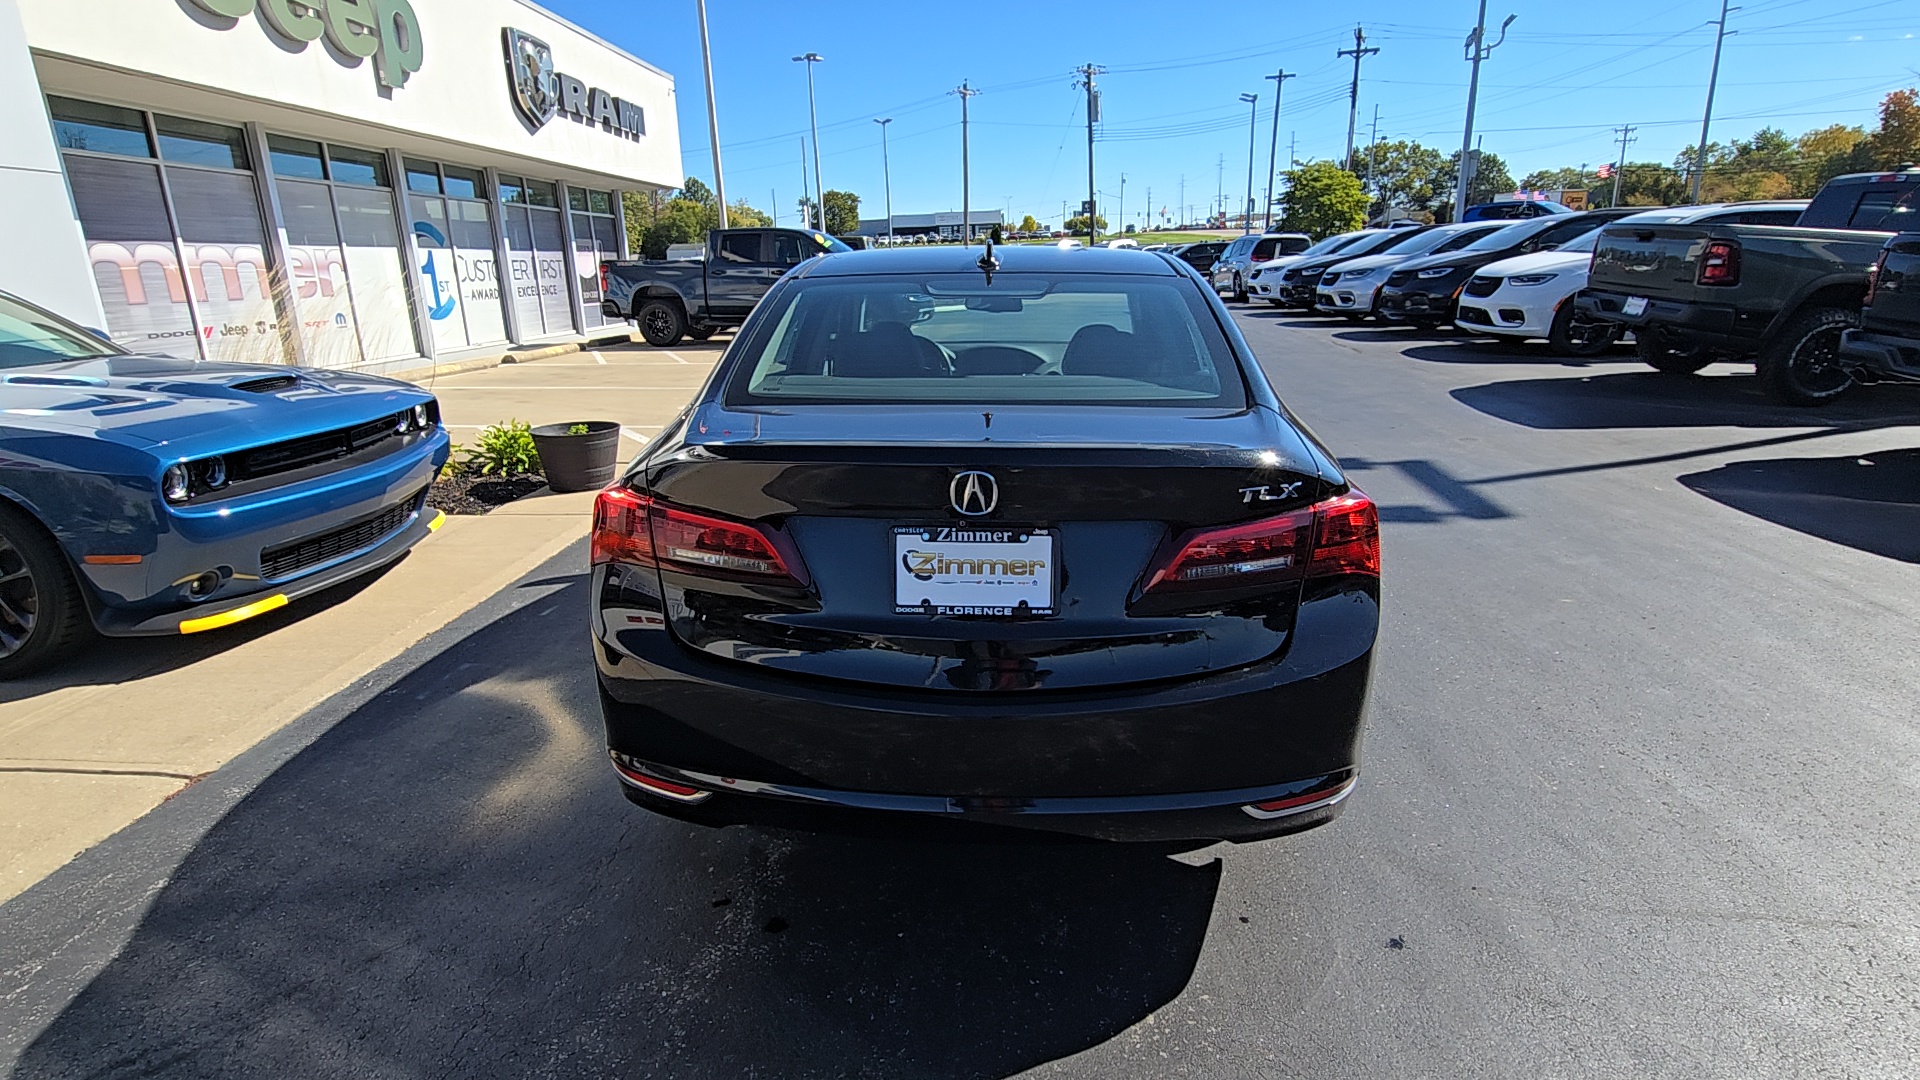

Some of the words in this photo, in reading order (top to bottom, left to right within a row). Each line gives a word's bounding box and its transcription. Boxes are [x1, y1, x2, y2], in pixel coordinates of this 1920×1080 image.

[556, 73, 646, 137] RAM
[457, 255, 531, 282] CUSTOER
[471, 288, 499, 301] AWARD
[517, 285, 558, 298] EXCELENCE
[148, 330, 196, 340] DODG
[220, 323, 249, 337] Jeep
[1238, 481, 1303, 503] TLX
[936, 527, 1013, 543] Zimmer
[911, 551, 1046, 576] Zimmer
[937, 606, 1013, 615] FLORENCE
